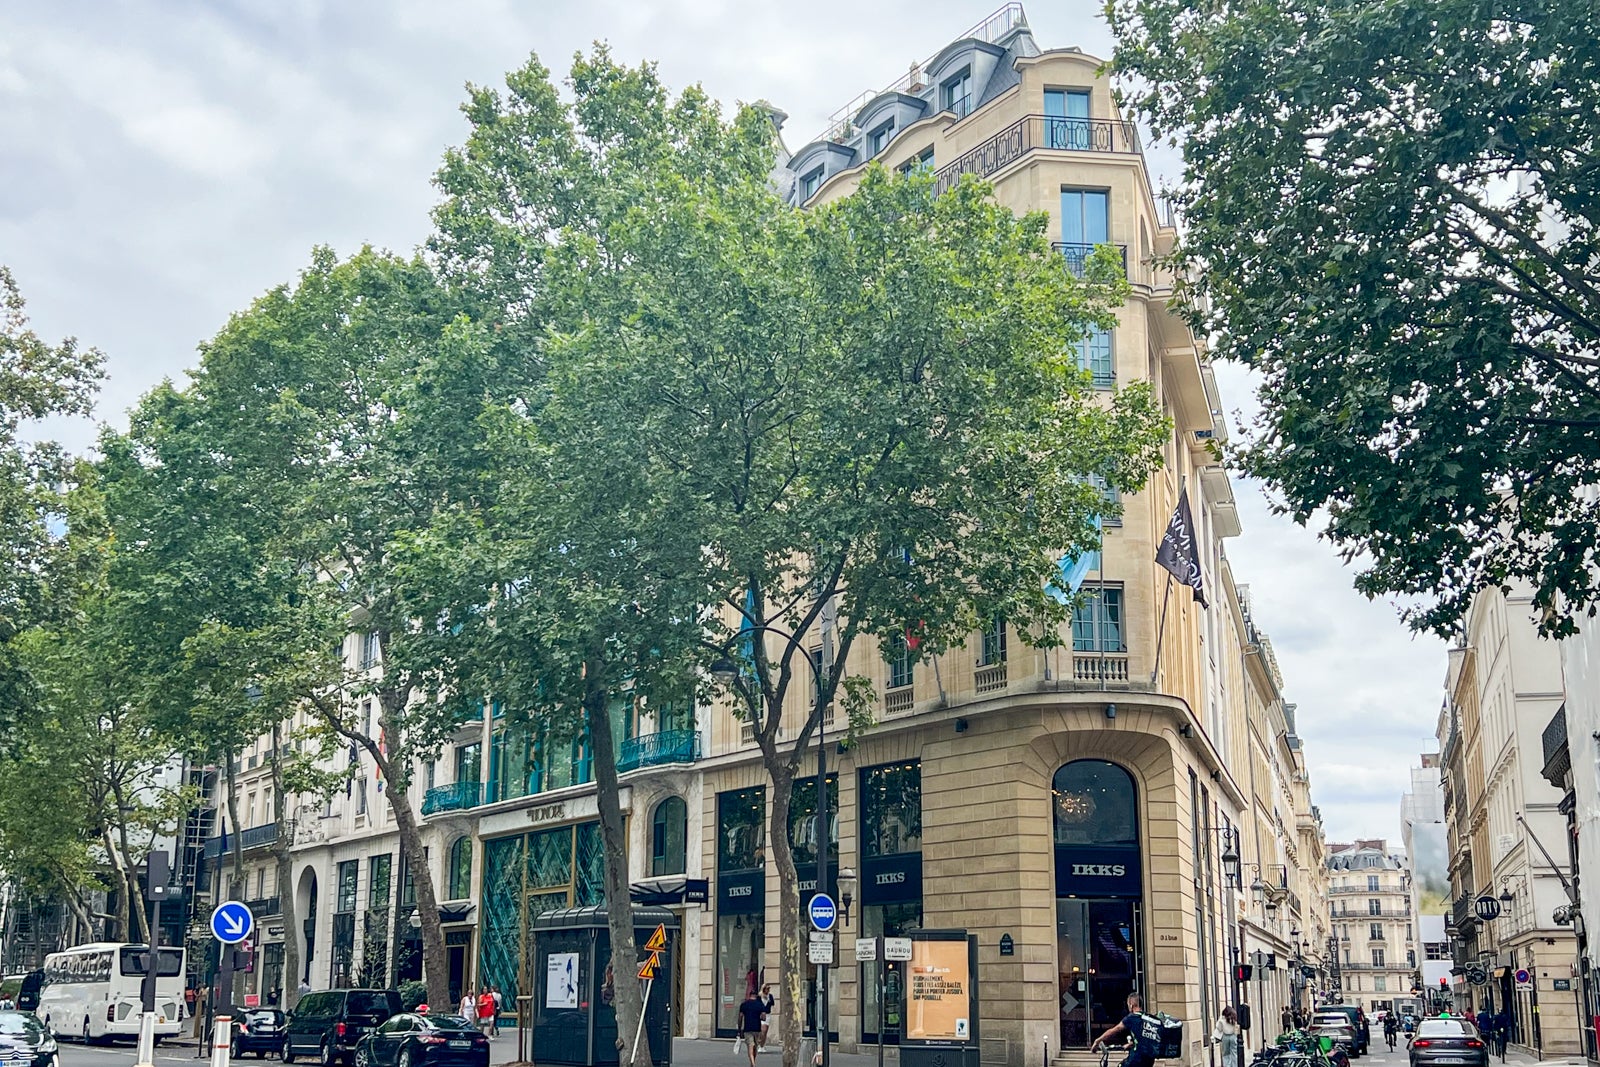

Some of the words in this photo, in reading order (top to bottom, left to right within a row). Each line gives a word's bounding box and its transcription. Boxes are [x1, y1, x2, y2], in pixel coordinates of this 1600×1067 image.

[1072, 864, 1125, 876] IKKS
[876, 872, 905, 884] IKKS
[799, 880, 817, 890] IKK
[729, 886, 752, 897] IKKS
[1476, 901, 1498, 914] ARTY
